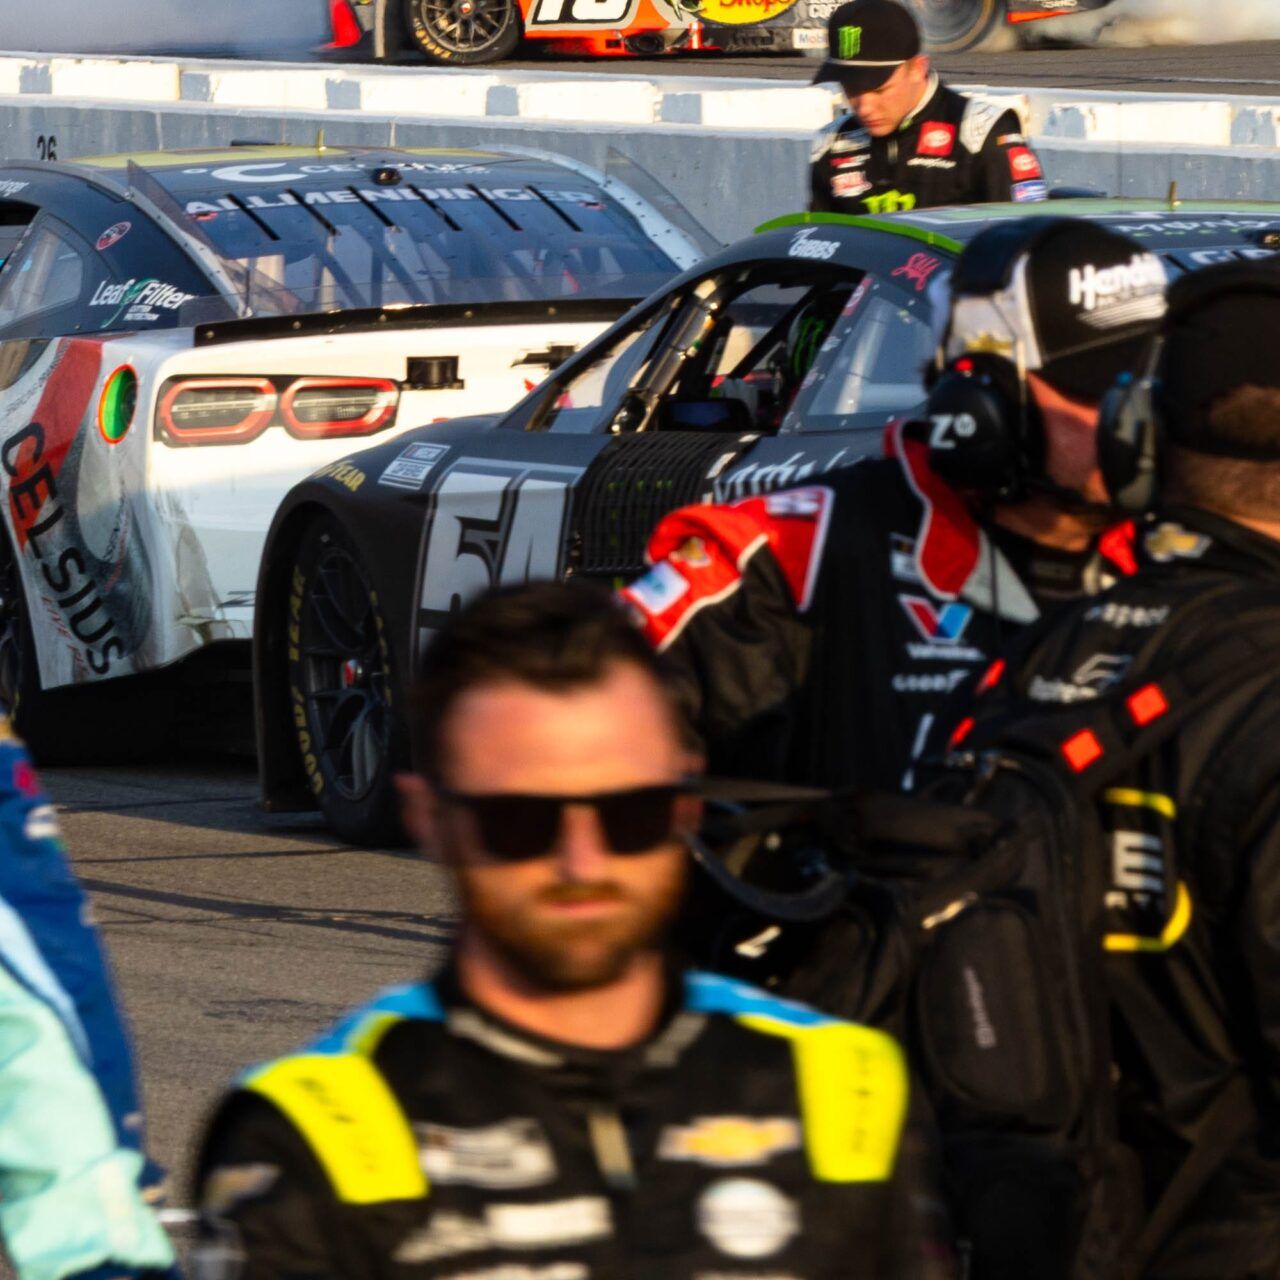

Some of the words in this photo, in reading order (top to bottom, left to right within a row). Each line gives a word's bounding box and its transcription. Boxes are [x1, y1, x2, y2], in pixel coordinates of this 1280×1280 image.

[184, 186, 602, 216] ALLMENDINGER
[787, 239, 841, 260] GIBBS
[1, 422, 122, 675] CELSIUS
